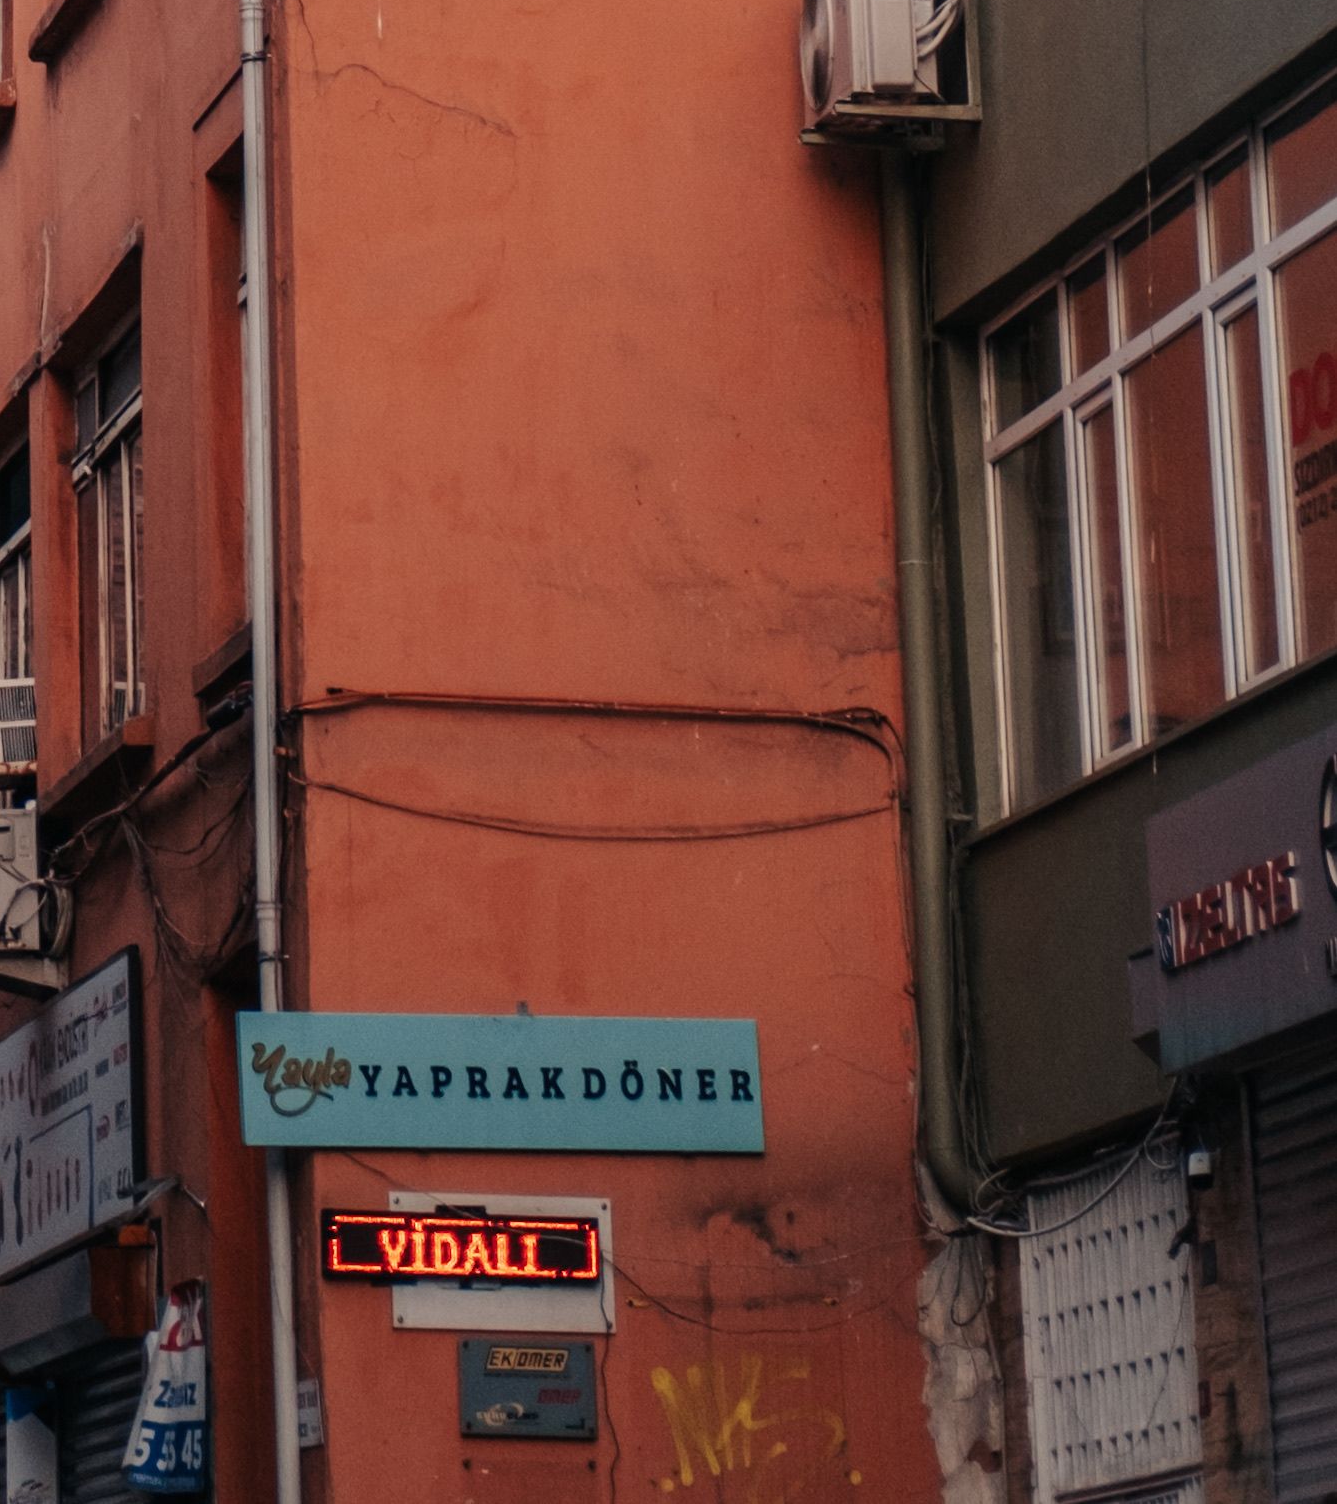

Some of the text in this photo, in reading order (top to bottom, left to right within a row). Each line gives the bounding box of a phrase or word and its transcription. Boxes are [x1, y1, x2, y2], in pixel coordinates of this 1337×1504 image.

[251, 1041, 754, 1117] Yayla YAPRAK DÖNER
[376, 1219, 543, 1273] VİDALI
